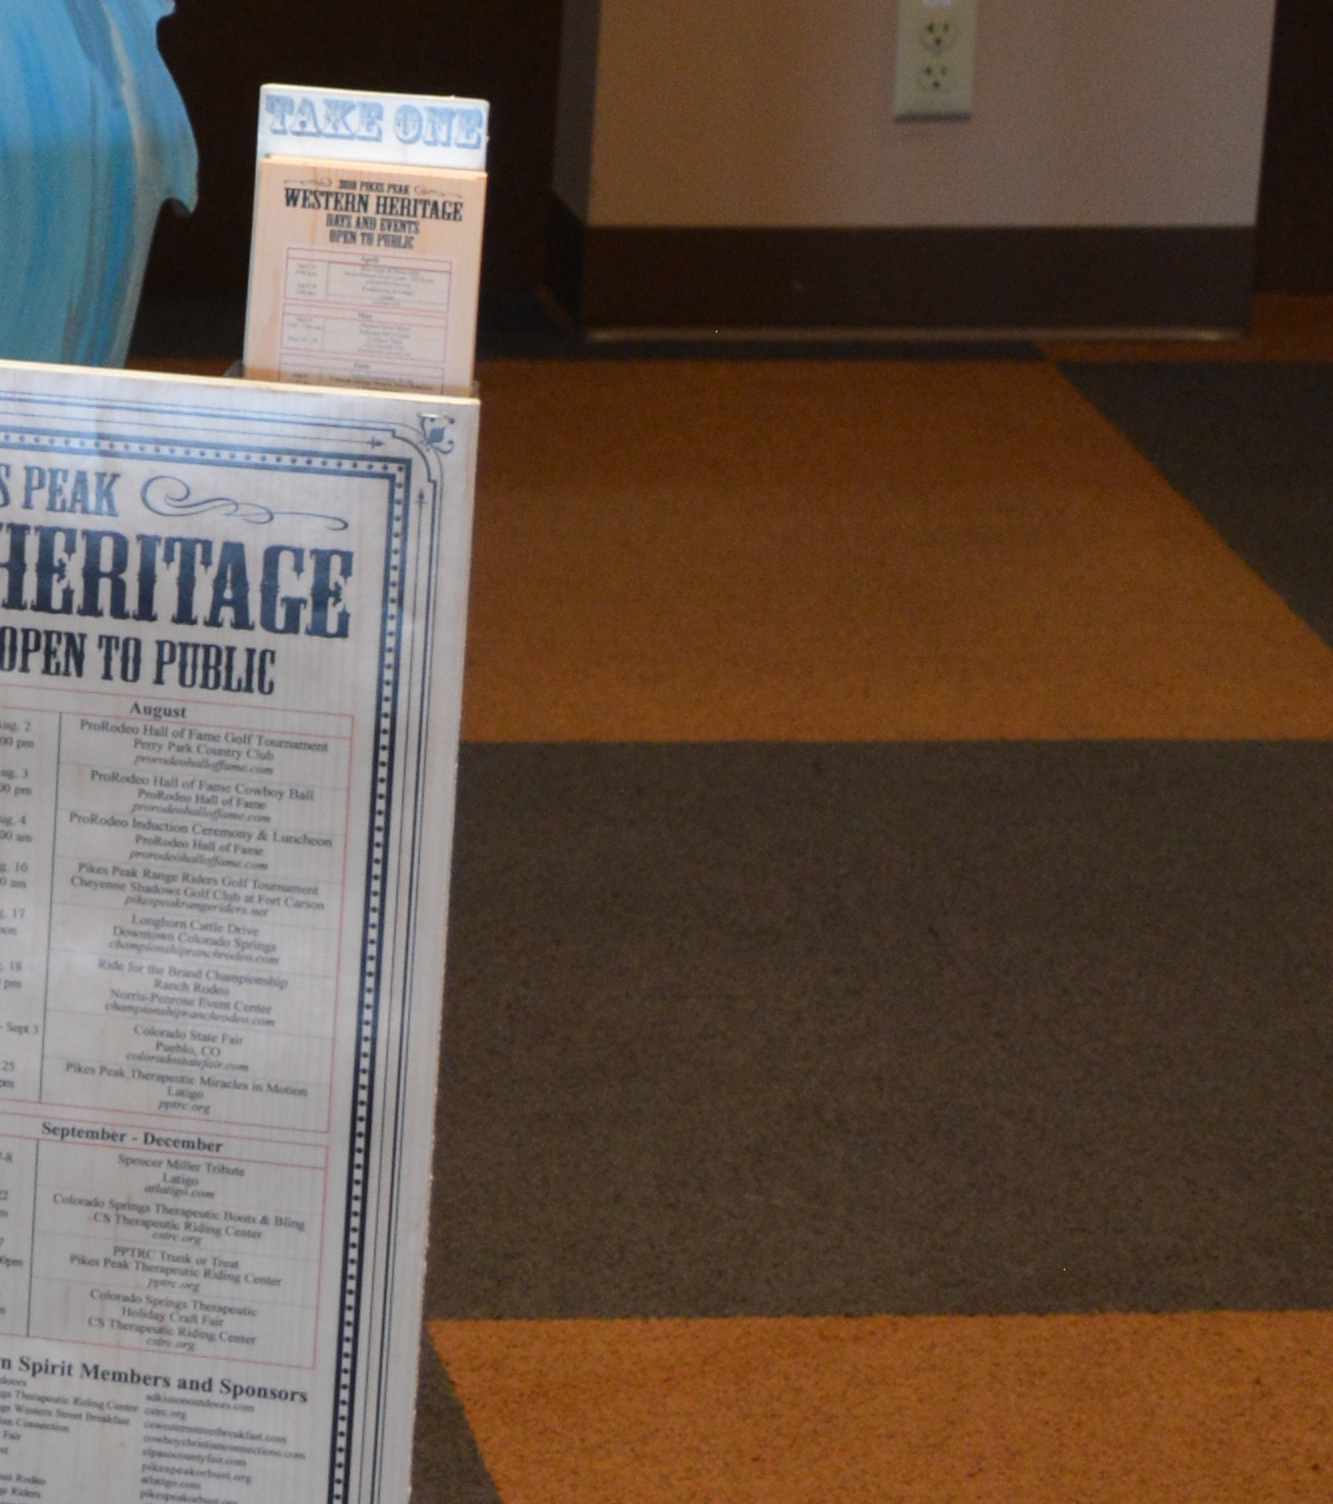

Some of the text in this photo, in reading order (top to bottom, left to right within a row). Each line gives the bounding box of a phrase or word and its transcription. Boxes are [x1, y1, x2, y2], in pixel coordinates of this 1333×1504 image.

[265, 94, 485, 149] TAKE ONE
[284, 187, 464, 222] WESTERN HERITAGE
[326, 214, 420, 234] DAYS AND EVENTS
[329, 229, 414, 249] OPEN TO PUBLIC
[21, 465, 121, 517] PEAK
[97, 634, 142, 684] TO
[152, 639, 276, 696] PUBLIC
[23, 720, 32, 733] 2
[129, 701, 187, 721] August
[15, 739, 35, 751] pm
[79, 718, 329, 753] ProRodeo Hall of Fame Golf Tournament
[133, 1024, 244, 1046] Colorado State Fair
[41, 1121, 127, 1143] September
[142, 1131, 224, 1153] December
[18, 1355, 73, 1378] Spirit
[80, 1362, 171, 1388] Members
[176, 1376, 213, 1393] and
[219, 1378, 308, 1404] Sponsors
